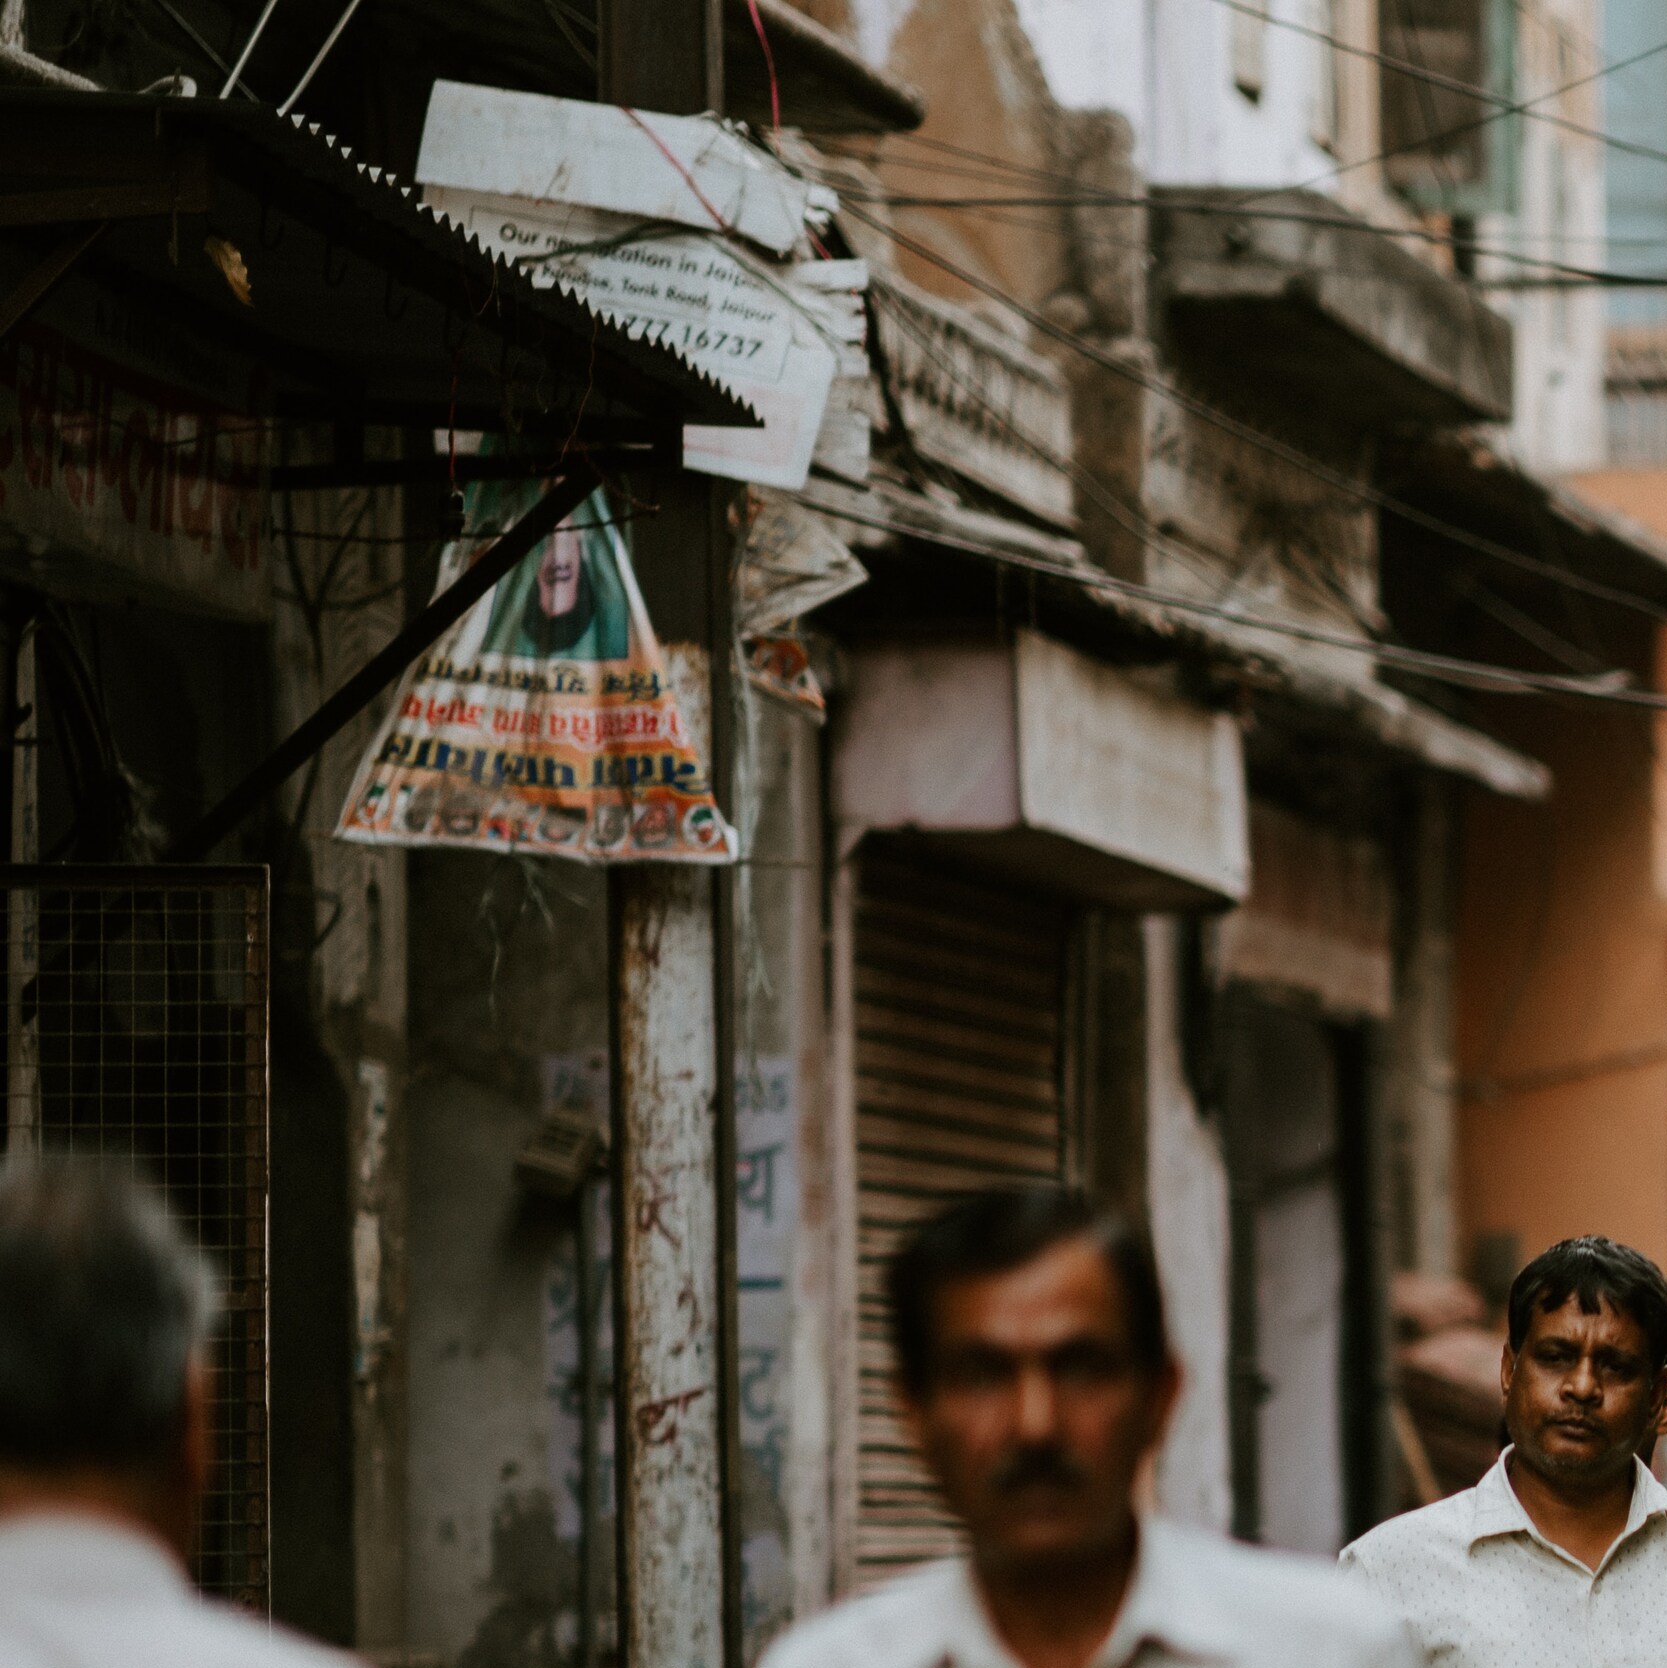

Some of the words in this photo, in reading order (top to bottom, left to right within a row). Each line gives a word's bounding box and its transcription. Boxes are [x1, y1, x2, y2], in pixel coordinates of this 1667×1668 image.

[500, 222, 539, 245] Our
[678, 253, 698, 273] in
[683, 324, 763, 359] 16737
